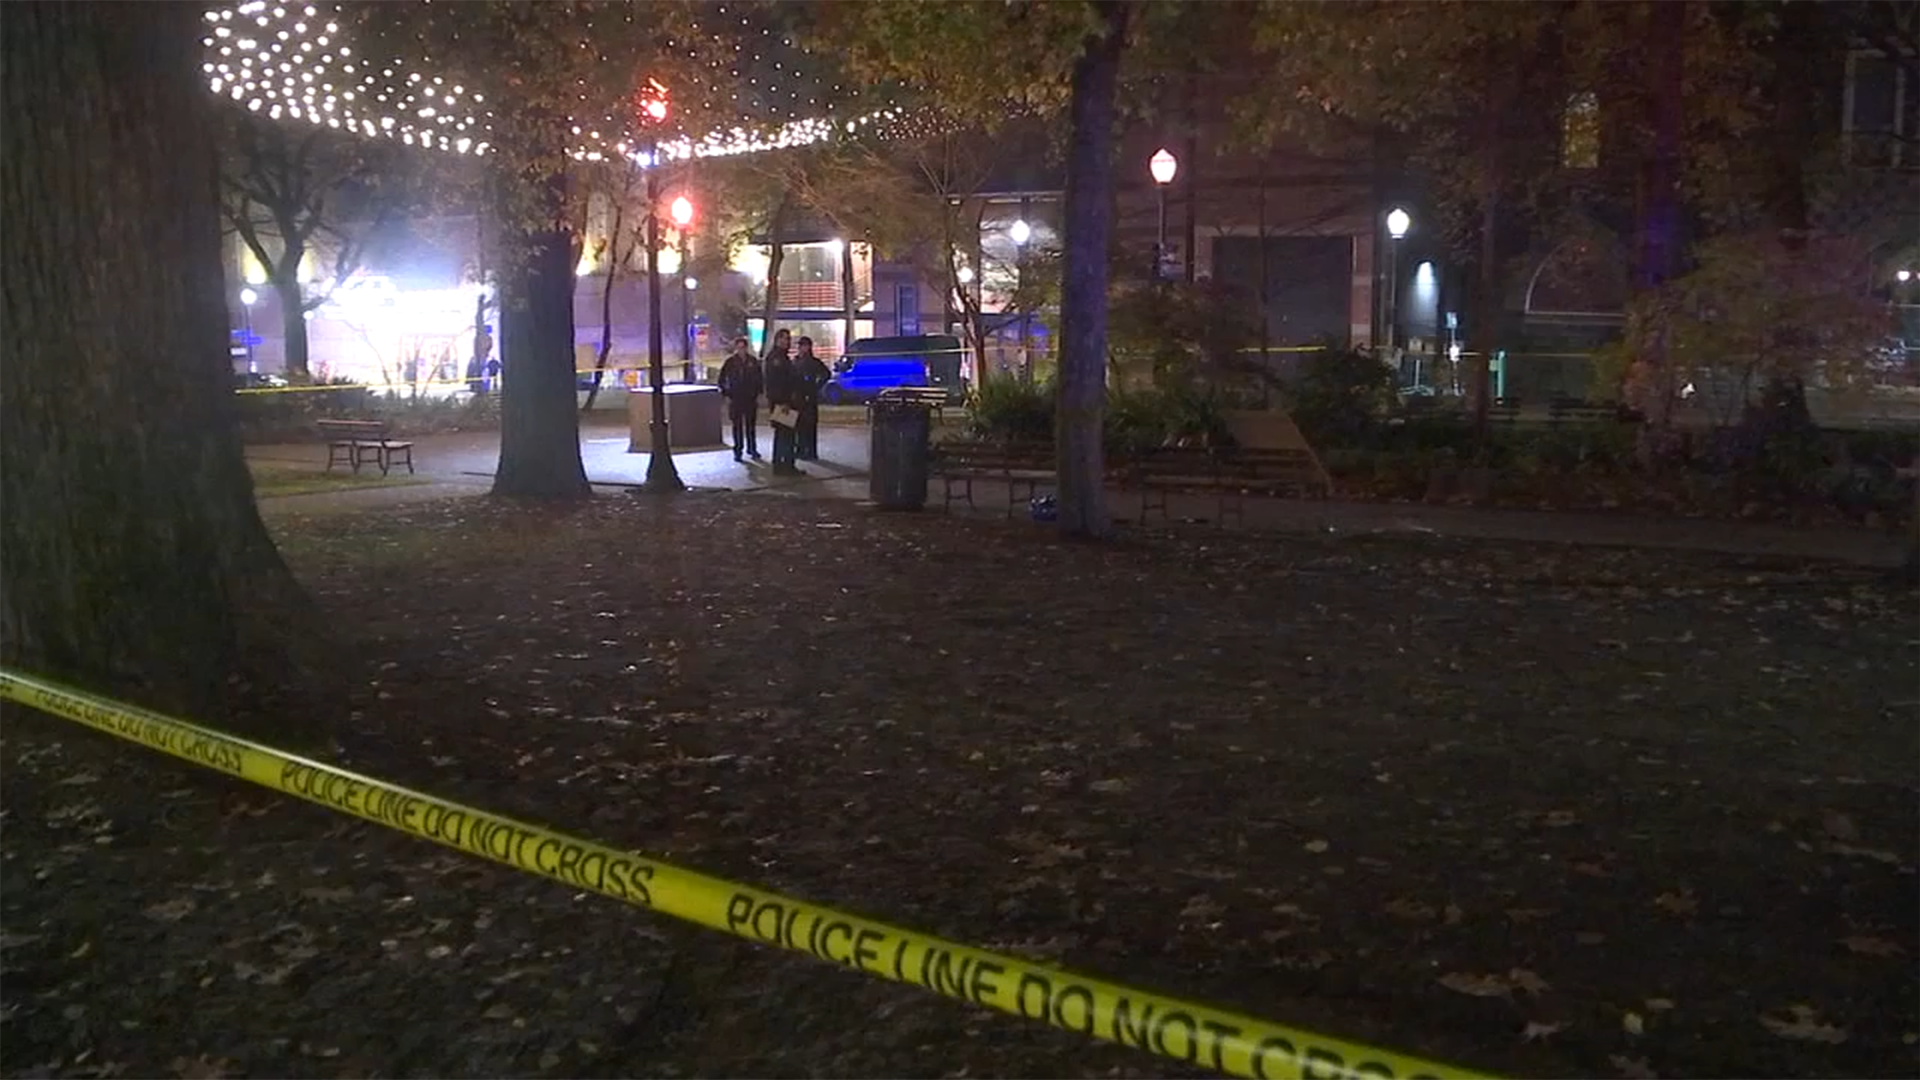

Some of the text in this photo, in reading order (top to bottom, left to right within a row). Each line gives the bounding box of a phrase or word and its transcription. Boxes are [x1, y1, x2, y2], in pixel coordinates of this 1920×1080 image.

[281, 761, 653, 904] POLICE LINE DO NOT CROSS
[727, 892, 885, 977] POLICE
[894, 940, 1005, 1002] LINE
[1018, 973, 1095, 1036] DO
[1112, 996, 1240, 1073] NOT
